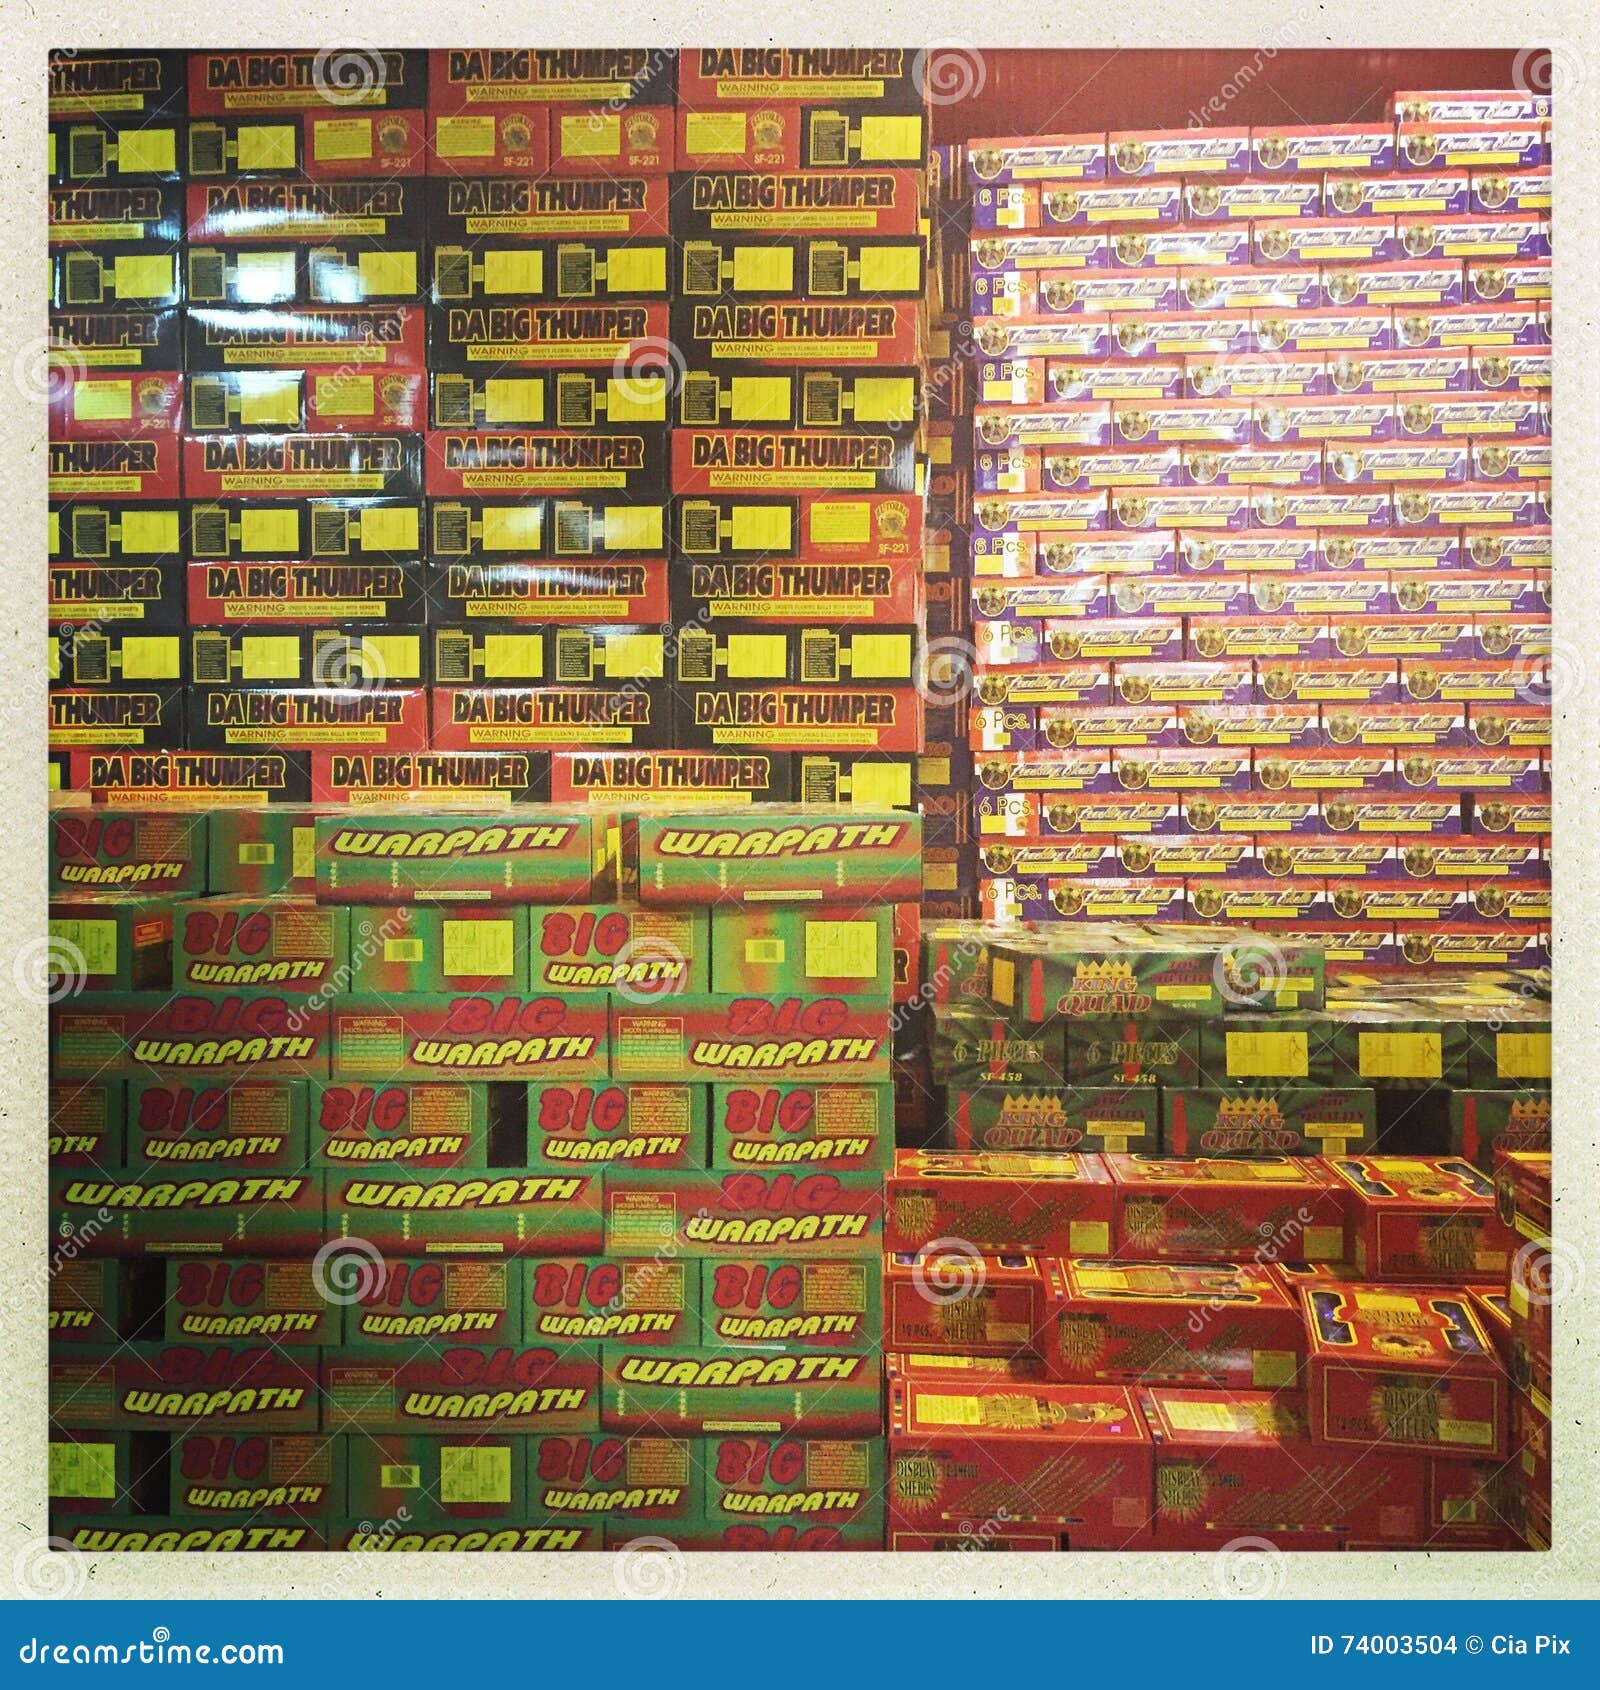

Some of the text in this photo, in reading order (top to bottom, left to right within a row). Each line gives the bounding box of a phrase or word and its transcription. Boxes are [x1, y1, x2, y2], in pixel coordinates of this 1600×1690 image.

[50, 57, 161, 91] THUMPER
[699, 48, 903, 78] DA BIG THUMPER
[719, 82, 780, 92] WARNING
[50, 185, 161, 221] THUMPER
[448, 178, 648, 215] DA BIG THUMPER
[693, 174, 896, 210] DA BIG THUMPER
[979, 188, 992, 206] 6
[469, 218, 528, 229] WARNING
[713, 213, 774, 224] WARNING
[694, 305, 896, 339] DA BIG THUMPER
[713, 343, 774, 353] WARNING
[983, 363, 996, 381] 6
[49, 440, 158, 473] THUMPER
[204, 438, 401, 471] DA BIG THUMPER
[692, 434, 895, 469] DA BIG THUMPER
[224, 476, 283, 486] WARNING
[712, 472, 773, 482] WARNING
[975, 538, 987, 554] 6
[50, 567, 162, 599] THUMPER
[207, 566, 404, 599] DA BIG THUMPER
[692, 564, 892, 599] DA BIG THUMPER
[226, 603, 285, 613] WARNING
[712, 602, 771, 612] WARNING
[982, 623, 994, 641] 6
[50, 693, 162, 725] THUMPER
[695, 692, 896, 726] DA BIG THUMPER
[975, 711, 987, 728] 6
[228, 729, 286, 739] WARNING
[715, 730, 774, 739] WARNING
[90, 756, 286, 788] DA BIG THUMPER
[331, 755, 529, 789] DA BIG THUMPER
[571, 755, 771, 789] DA BIG THUMPER
[110, 792, 168, 802] WARNING
[979, 796, 992, 816] 6
[55, 818, 135, 858] BIG
[335, 826, 569, 856] WARPATH
[659, 824, 900, 855] WARPATH
[61, 862, 184, 883] WARPATH
[987, 882, 998, 900] 6
[183, 911, 271, 955] BIG
[540, 912, 629, 957] BIG
[190, 960, 325, 982] WARPATH
[1071, 976, 1138, 993] KING
[169, 996, 289, 1034] BIG
[447, 997, 568, 1034] BIG
[728, 997, 849, 1035] BIG
[1057, 994, 1152, 1017] QUAD
[134, 1037, 315, 1065] WARPATH
[412, 1037, 595, 1066] WARPATH
[693, 1037, 876, 1067] WARPATH
[953, 1040, 967, 1063] 6
[1086, 1040, 1100, 1063] 6
[1112, 1073, 1157, 1083] SF-458
[139, 1087, 227, 1132] BIG
[319, 1087, 408, 1132] BIG
[537, 1089, 627, 1132] BIG
[724, 1089, 813, 1133] BIG
[1000, 1110, 1068, 1127] KING
[1213, 1113, 1285, 1130] KING
[146, 1136, 281, 1160] WARPATH
[327, 1136, 463, 1160] WARPATH
[546, 1136, 682, 1160] WARPATH
[733, 1138, 869, 1162] WARPATH
[984, 1127, 1083, 1148] QUAD
[1200, 1130, 1300, 1150] QUAD
[65, 1177, 302, 1207] WARPATH
[346, 1177, 582, 1207] WARPATH
[721, 1173, 841, 1211] BIG
[686, 1214, 869, 1243] WARPATH
[177, 1263, 265, 1306] BIG
[533, 1263, 621, 1307] BIG
[712, 1264, 800, 1309] BIG
[183, 1313, 317, 1336] WARPATH
[362, 1312, 497, 1336] WARPATH
[540, 1312, 679, 1336] WARPATH
[720, 1315, 857, 1338] WARPATH
[622, 1356, 860, 1384] WARPATH
[124, 1388, 304, 1416] WARPATH
[405, 1388, 586, 1417] WARPATH
[180, 1436, 267, 1481] BIG
[537, 1437, 625, 1482] BIG
[716, 1439, 801, 1485] BIG
[895, 1459, 937, 1478] DISPLAY
[188, 1486, 323, 1509] WARPATH
[545, 1488, 680, 1509] WARPATH
[724, 1491, 858, 1513] WARPATH
